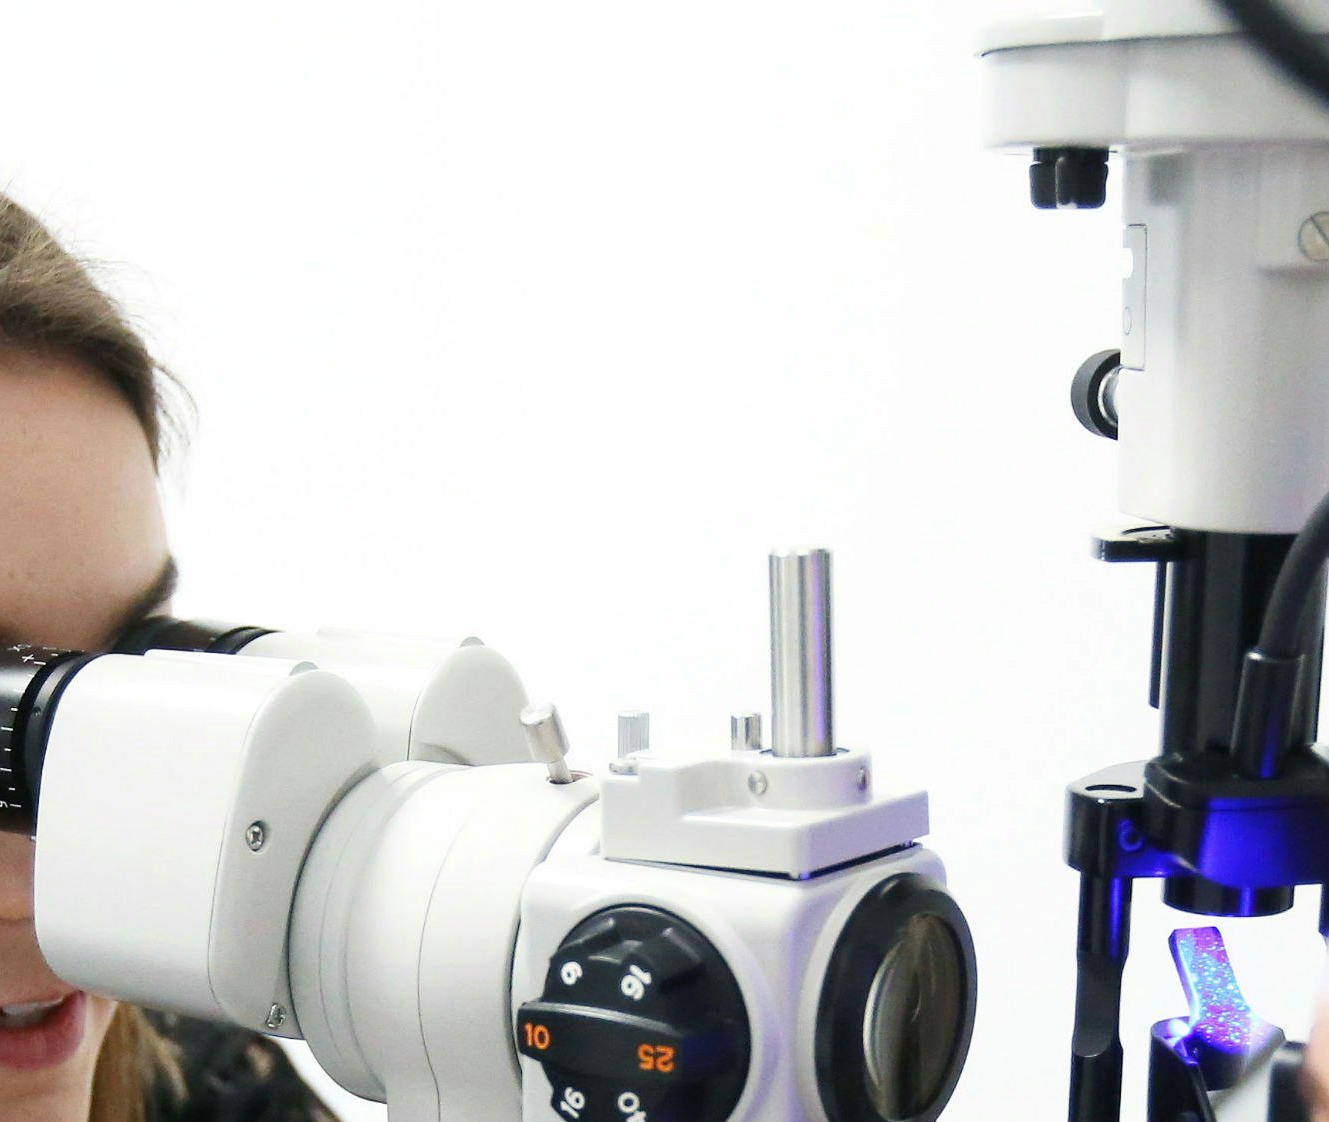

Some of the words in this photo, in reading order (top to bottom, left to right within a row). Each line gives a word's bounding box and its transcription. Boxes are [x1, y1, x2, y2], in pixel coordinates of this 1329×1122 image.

[621, 964, 652, 1001] 16
[524, 1022, 551, 1050] 10
[637, 1043, 675, 1073] 25
[560, 1087, 585, 1119] 16
